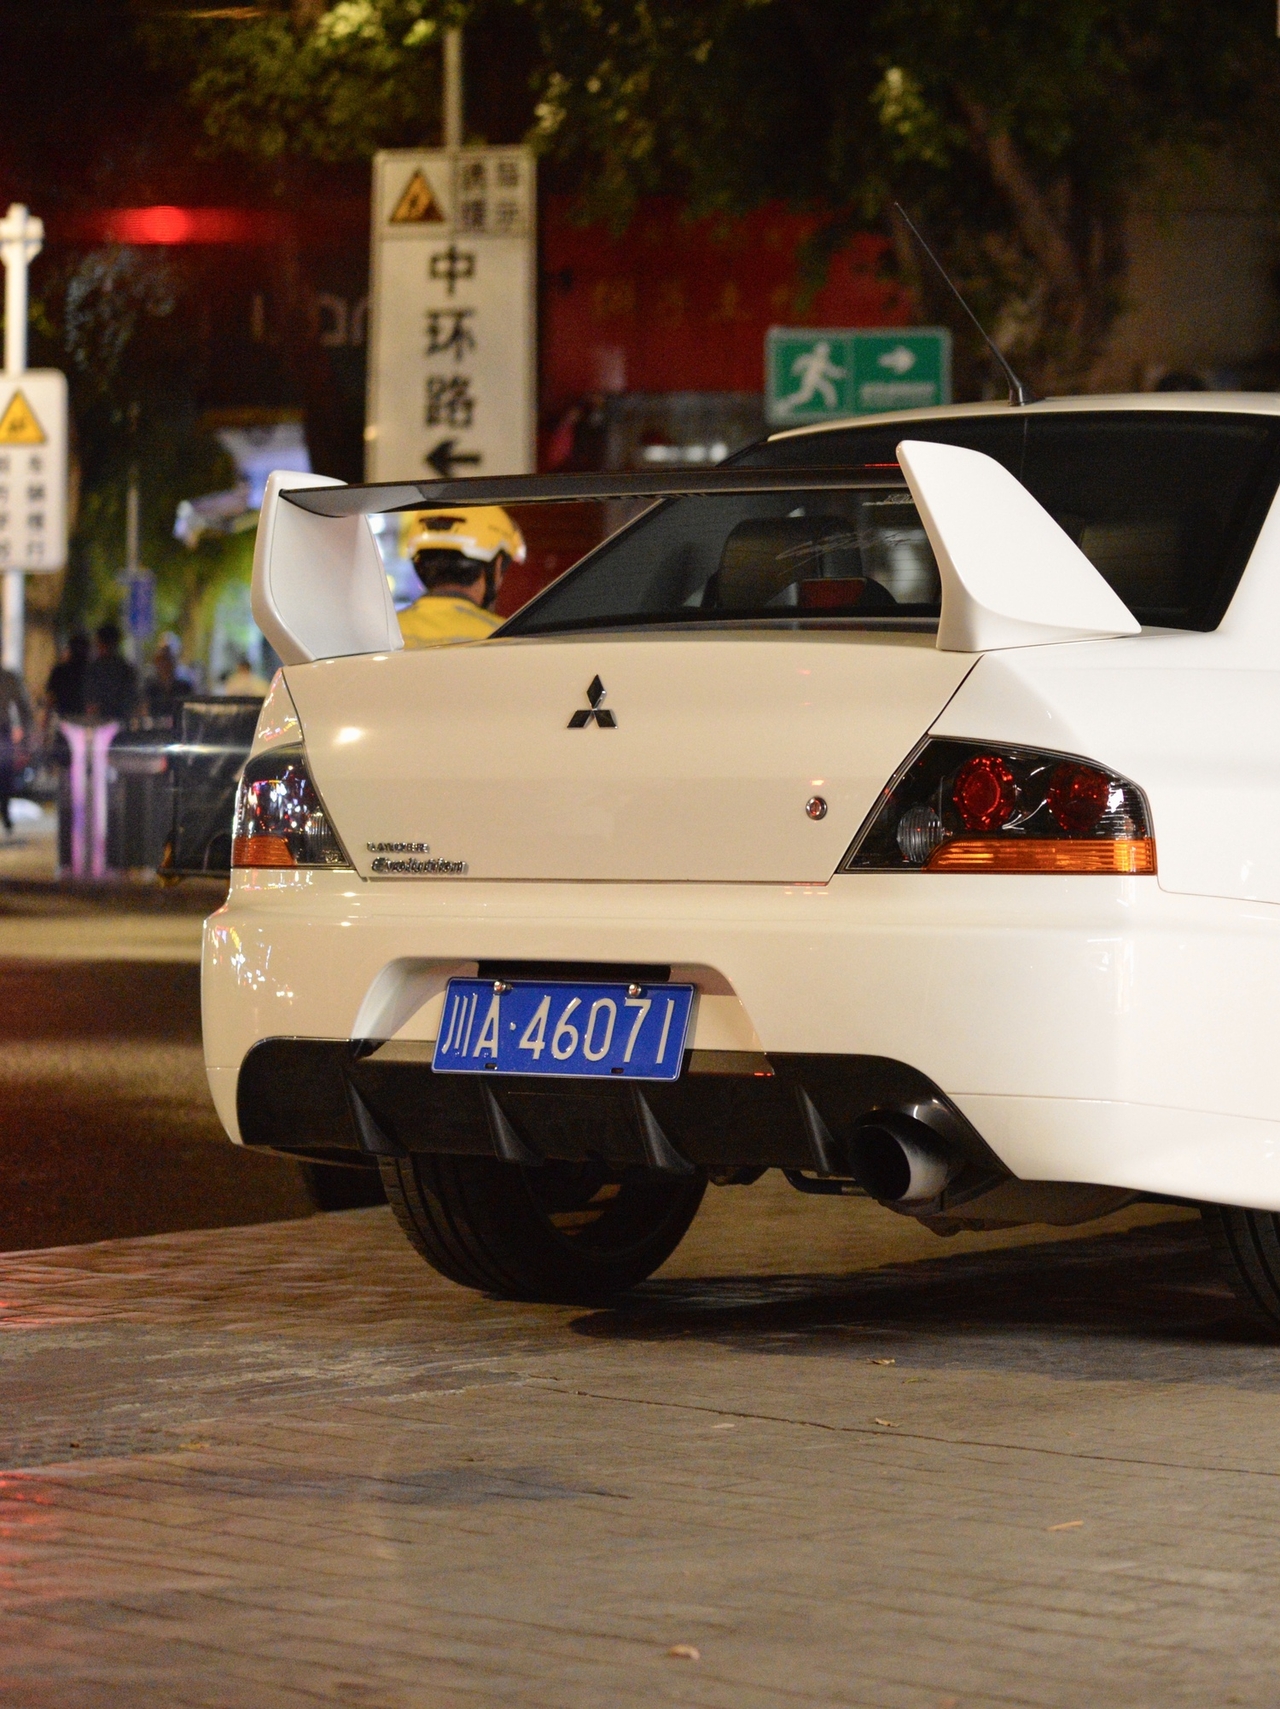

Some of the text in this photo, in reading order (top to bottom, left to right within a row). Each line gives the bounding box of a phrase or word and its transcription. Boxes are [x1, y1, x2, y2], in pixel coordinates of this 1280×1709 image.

[425, 244, 477, 428] 中环路
[441, 993, 675, 1065] 川A·46071
